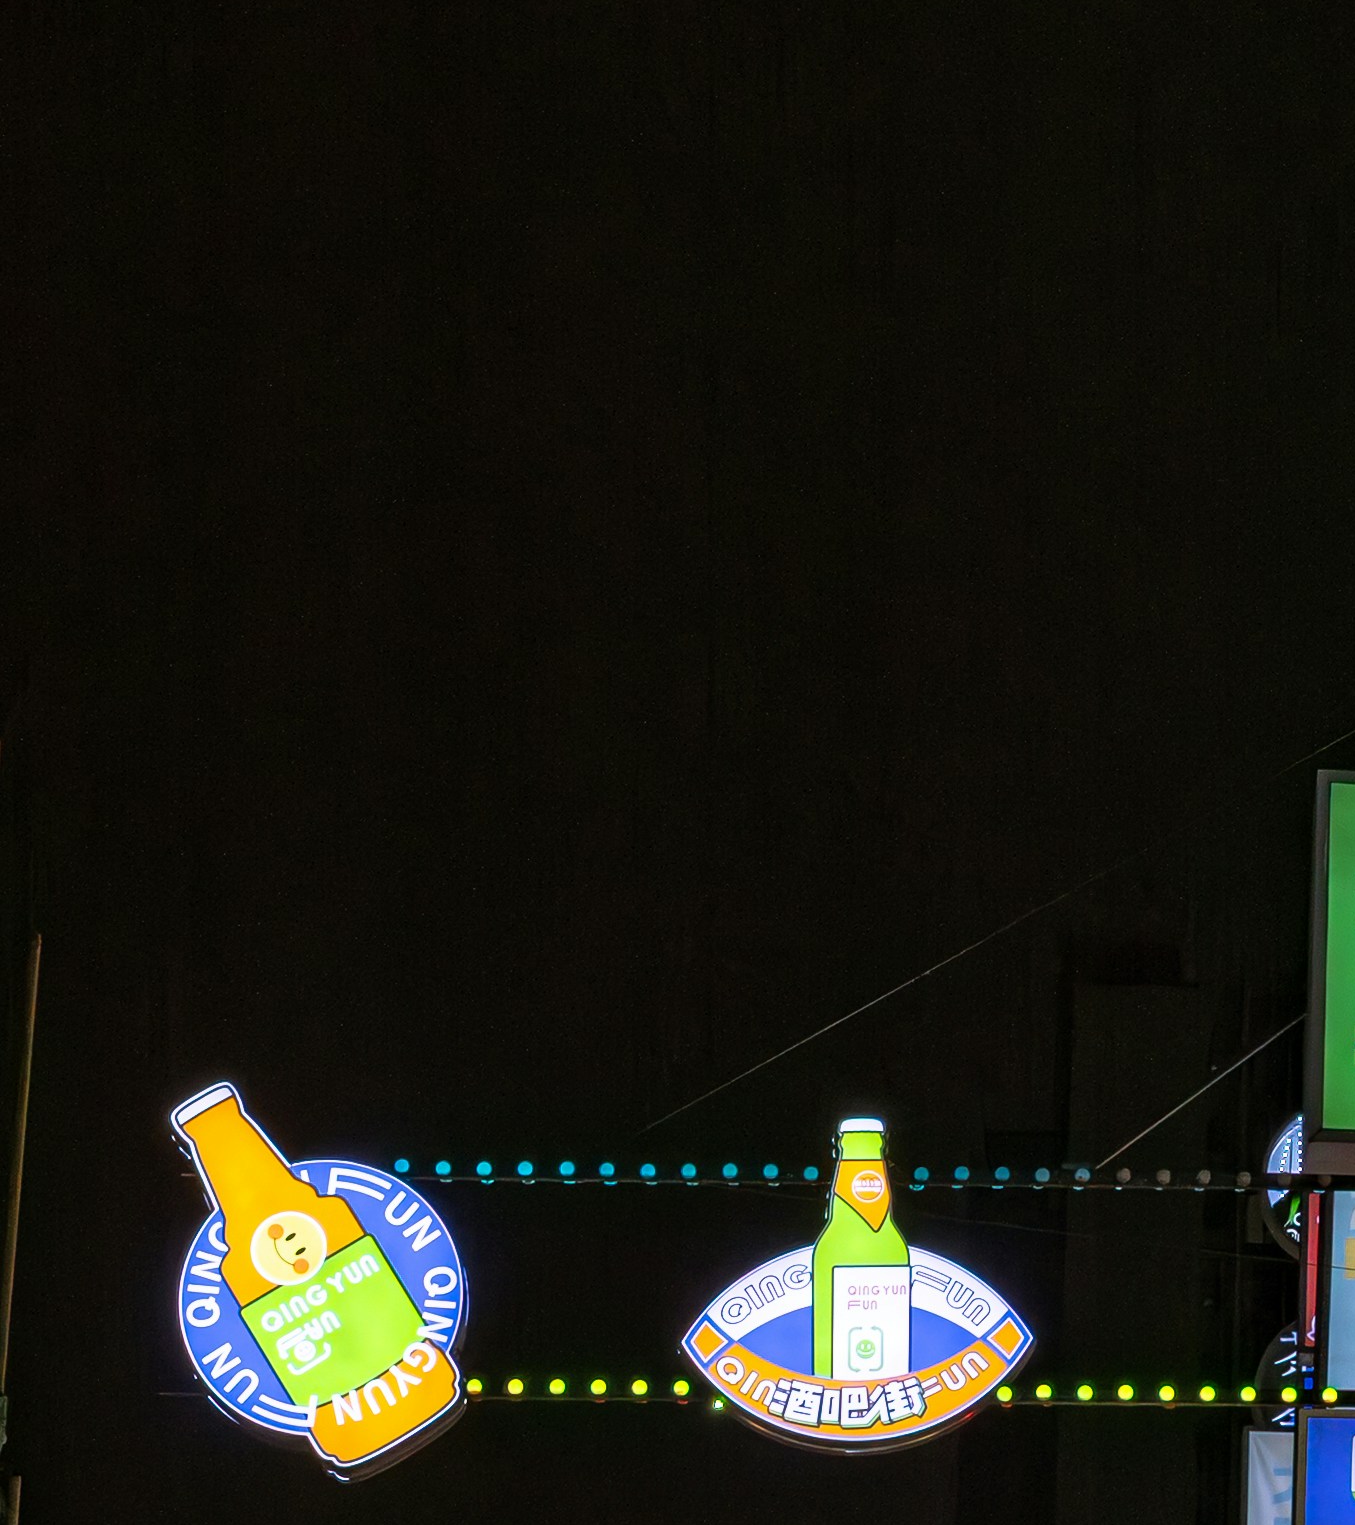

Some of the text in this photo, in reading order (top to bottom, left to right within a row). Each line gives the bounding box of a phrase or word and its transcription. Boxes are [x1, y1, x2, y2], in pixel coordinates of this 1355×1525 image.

[327, 1167, 442, 1252] FUN
[910, 1264, 992, 1327] FUN
[769, 1375, 928, 1429] 酒吧街
